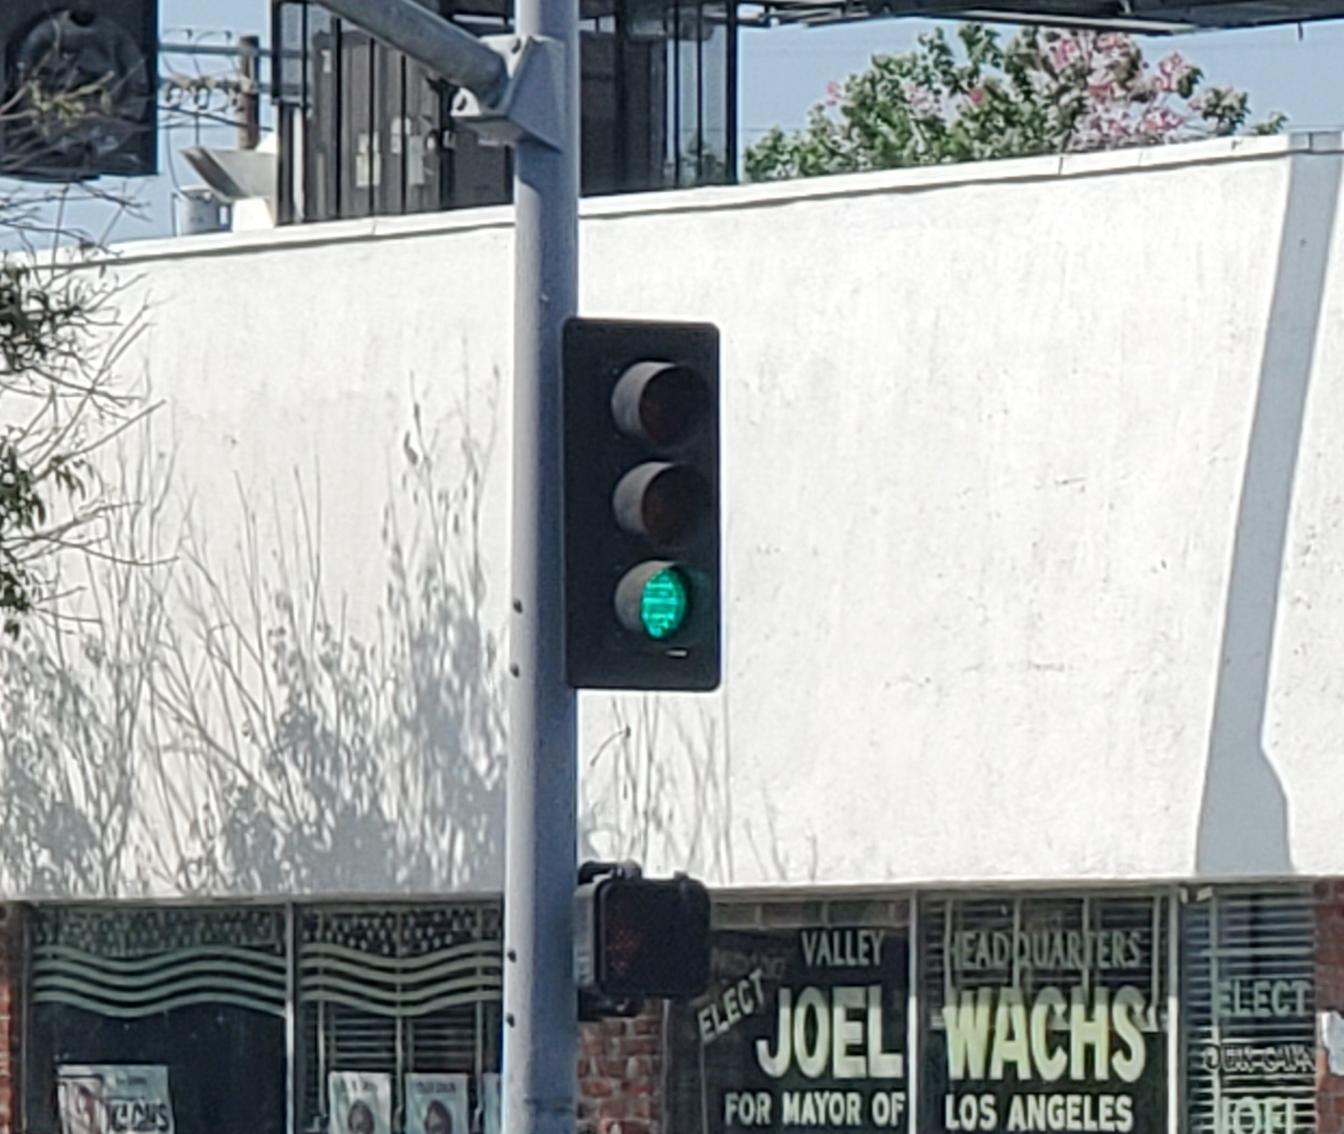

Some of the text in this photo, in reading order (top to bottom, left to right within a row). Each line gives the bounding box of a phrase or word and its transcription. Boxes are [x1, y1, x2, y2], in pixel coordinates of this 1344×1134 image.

[802, 929, 1142, 970] VALLEY HEADQUARTERS
[698, 968, 765, 1042] ELECT
[1213, 979, 1313, 1018] ELECT
[756, 985, 1147, 1083] JOEL WACHS
[725, 1091, 1135, 1133] FOR MAYOR OF LOS ANGELES
